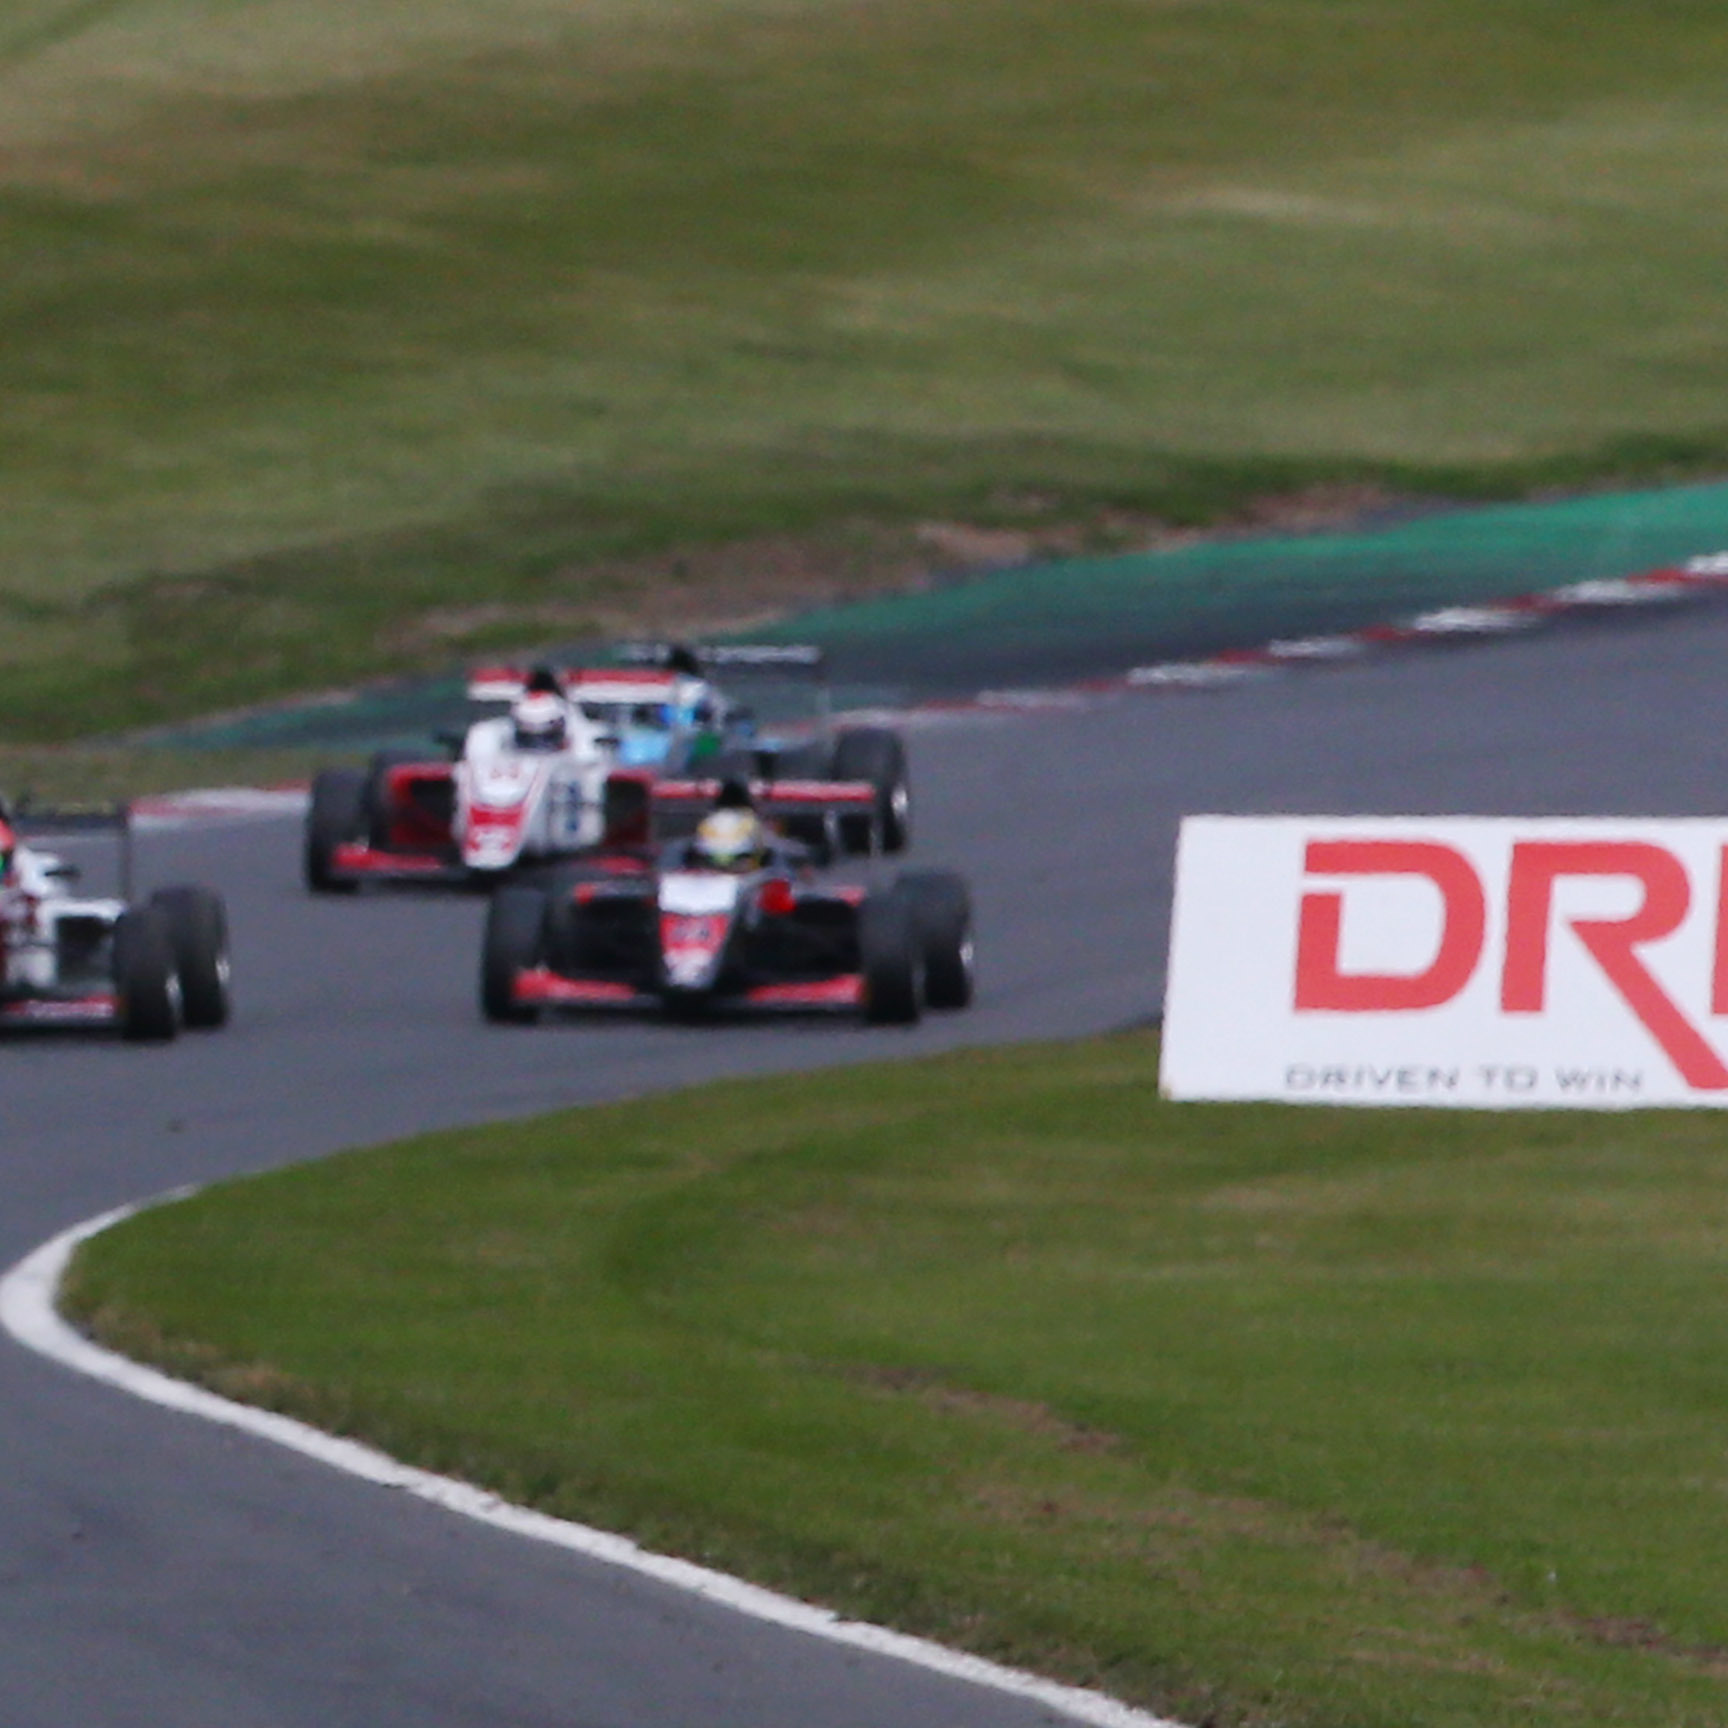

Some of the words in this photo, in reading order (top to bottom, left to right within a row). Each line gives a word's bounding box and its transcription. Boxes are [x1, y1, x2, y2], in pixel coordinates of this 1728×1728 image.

[1285, 1065, 1460, 1092] DRIVEN
[1477, 1066, 1539, 1093] TO
[1555, 1068, 1643, 1094] WIN
